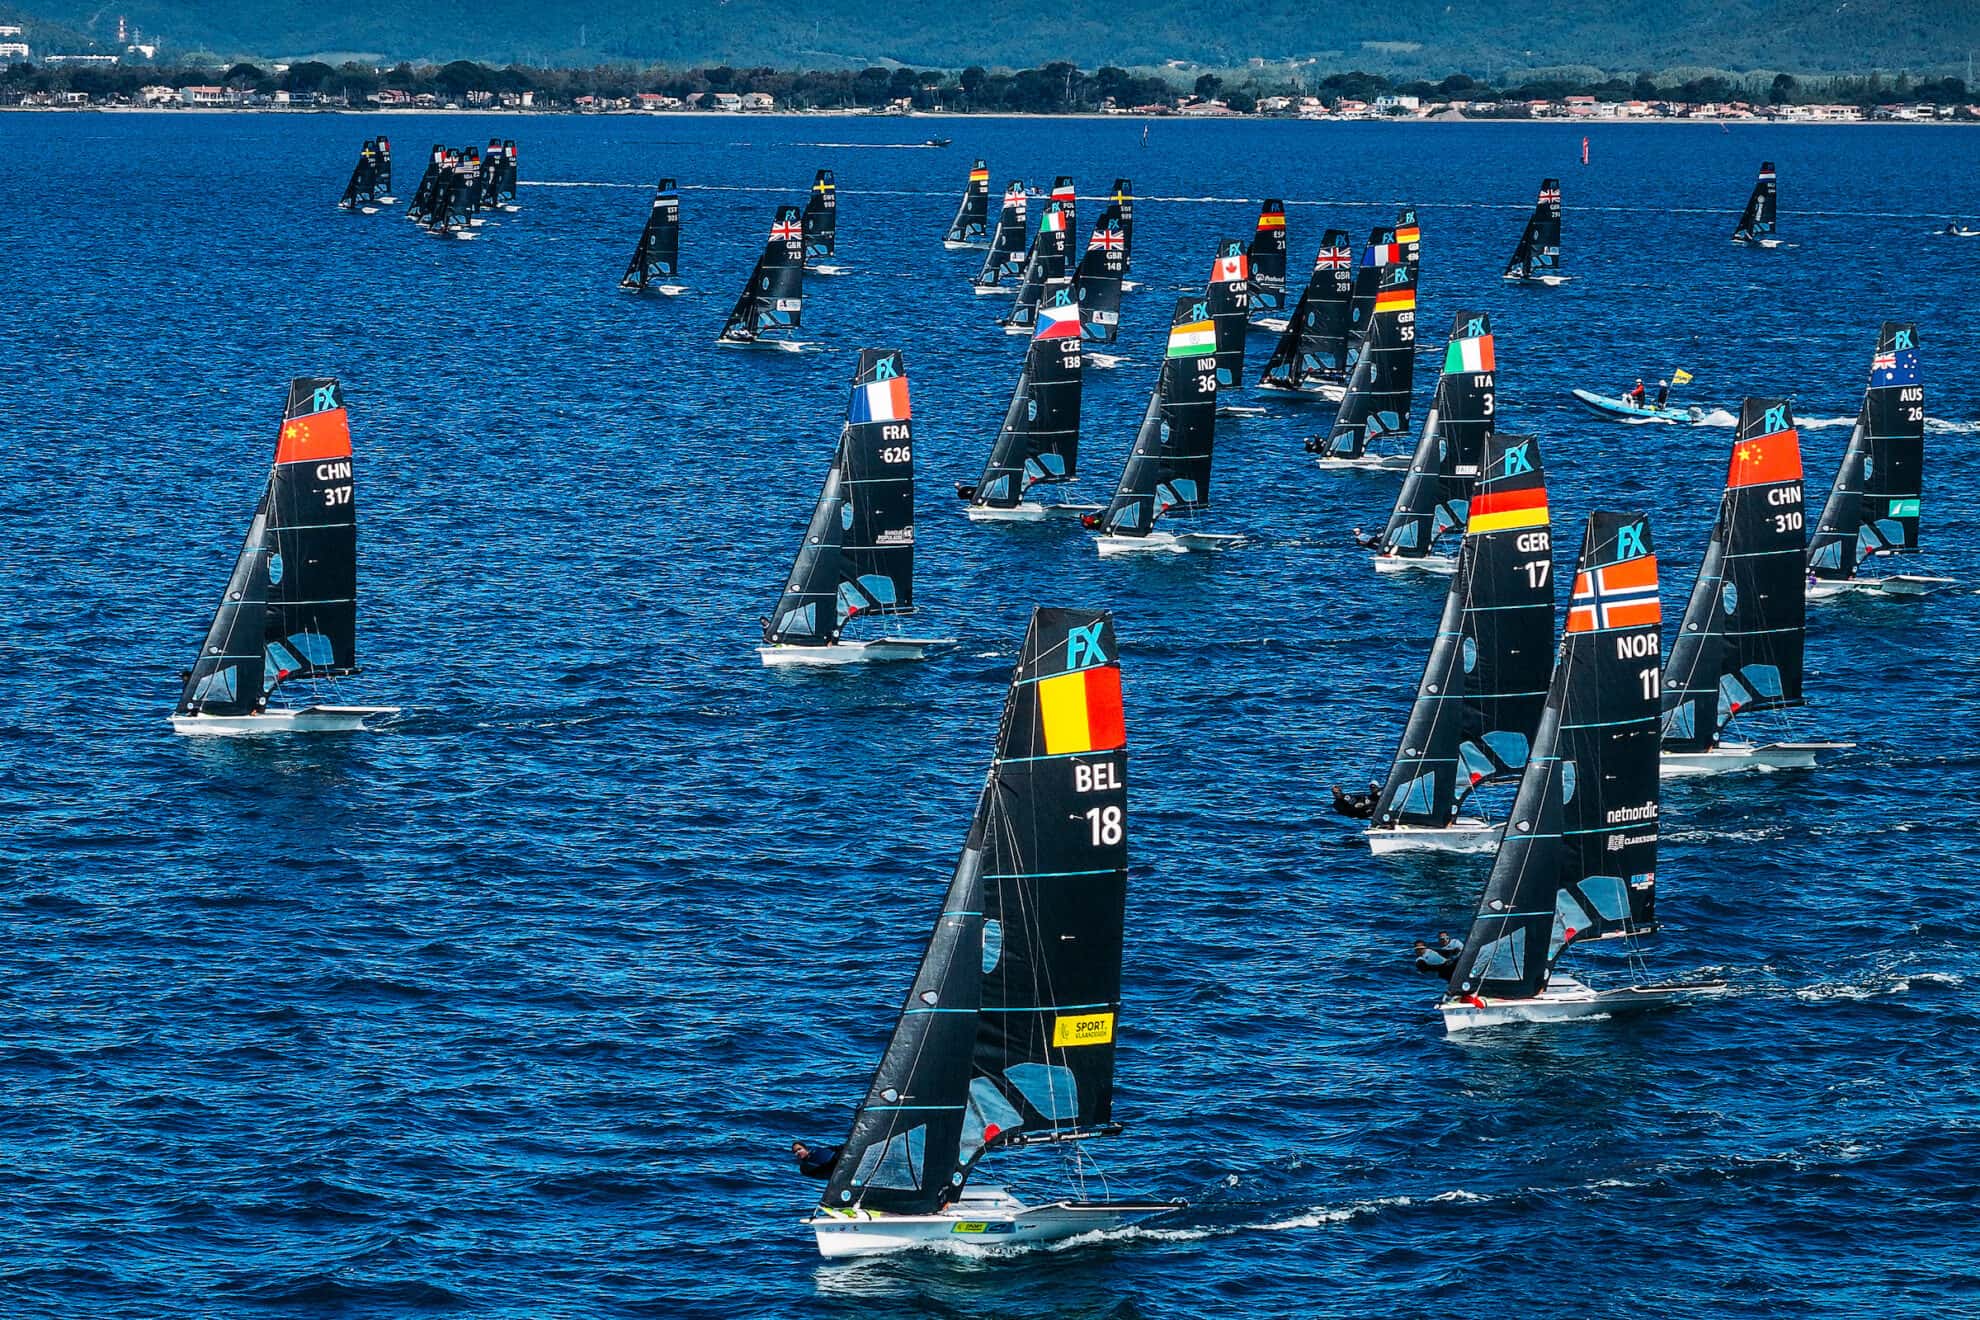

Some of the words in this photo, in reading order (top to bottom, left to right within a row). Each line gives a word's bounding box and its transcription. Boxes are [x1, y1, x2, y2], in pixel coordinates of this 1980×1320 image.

[1052, 202, 1061, 212] FX
[1065, 210, 1075, 219] 74
[1108, 218, 1120, 230] FX
[1406, 212, 1416, 223] FX
[1057, 241, 1064, 251] 15
[1277, 240, 1286, 250] 21
[1336, 234, 1348, 247] FX
[1383, 232, 1396, 244] FX
[788, 251, 802, 260] 713
[1106, 252, 1123, 260] GBR
[1229, 242, 1242, 257] FX
[1107, 262, 1121, 271] 148
[1335, 271, 1351, 281] GBR
[1394, 266, 1409, 284] FX
[1229, 281, 1247, 293] CAN
[1336, 282, 1351, 292] 281
[1055, 288, 1072, 308] FX
[1235, 294, 1247, 308] 71
[1192, 301, 1209, 321] FX
[1397, 311, 1414, 323] GER
[1400, 326, 1414, 341] 55
[1468, 317, 1485, 337] FX
[1060, 340, 1081, 352] CZE
[1895, 329, 1914, 349] FX
[876, 357, 899, 381] FX
[1063, 356, 1081, 369] 138
[1197, 357, 1217, 372] IND
[1198, 374, 1217, 394] 36
[1474, 374, 1493, 388] ITA
[313, 385, 338, 413] FX
[1900, 387, 1923, 402] AUS
[1483, 393, 1494, 416] 3
[1764, 405, 1789, 434] FX
[1907, 406, 1924, 422] 26
[882, 425, 910, 441] FRA
[883, 446, 911, 464] 626
[1504, 443, 1534, 477] FX
[316, 461, 352, 481] CHN
[324, 486, 352, 507] 317
[1767, 486, 1802, 507] CHN
[1775, 511, 1803, 535] 310
[1515, 533, 1550, 554] GER
[1616, 522, 1648, 561] FX
[1525, 560, 1551, 589] 17
[1066, 621, 1108, 670] FX
[1616, 632, 1659, 661] NOR
[1639, 666, 1660, 701] 11
[1074, 761, 1122, 793] BEL
[1607, 801, 1658, 823] netnordic
[1086, 806, 1123, 846] 18
[1075, 1020, 1106, 1033] SPORT
